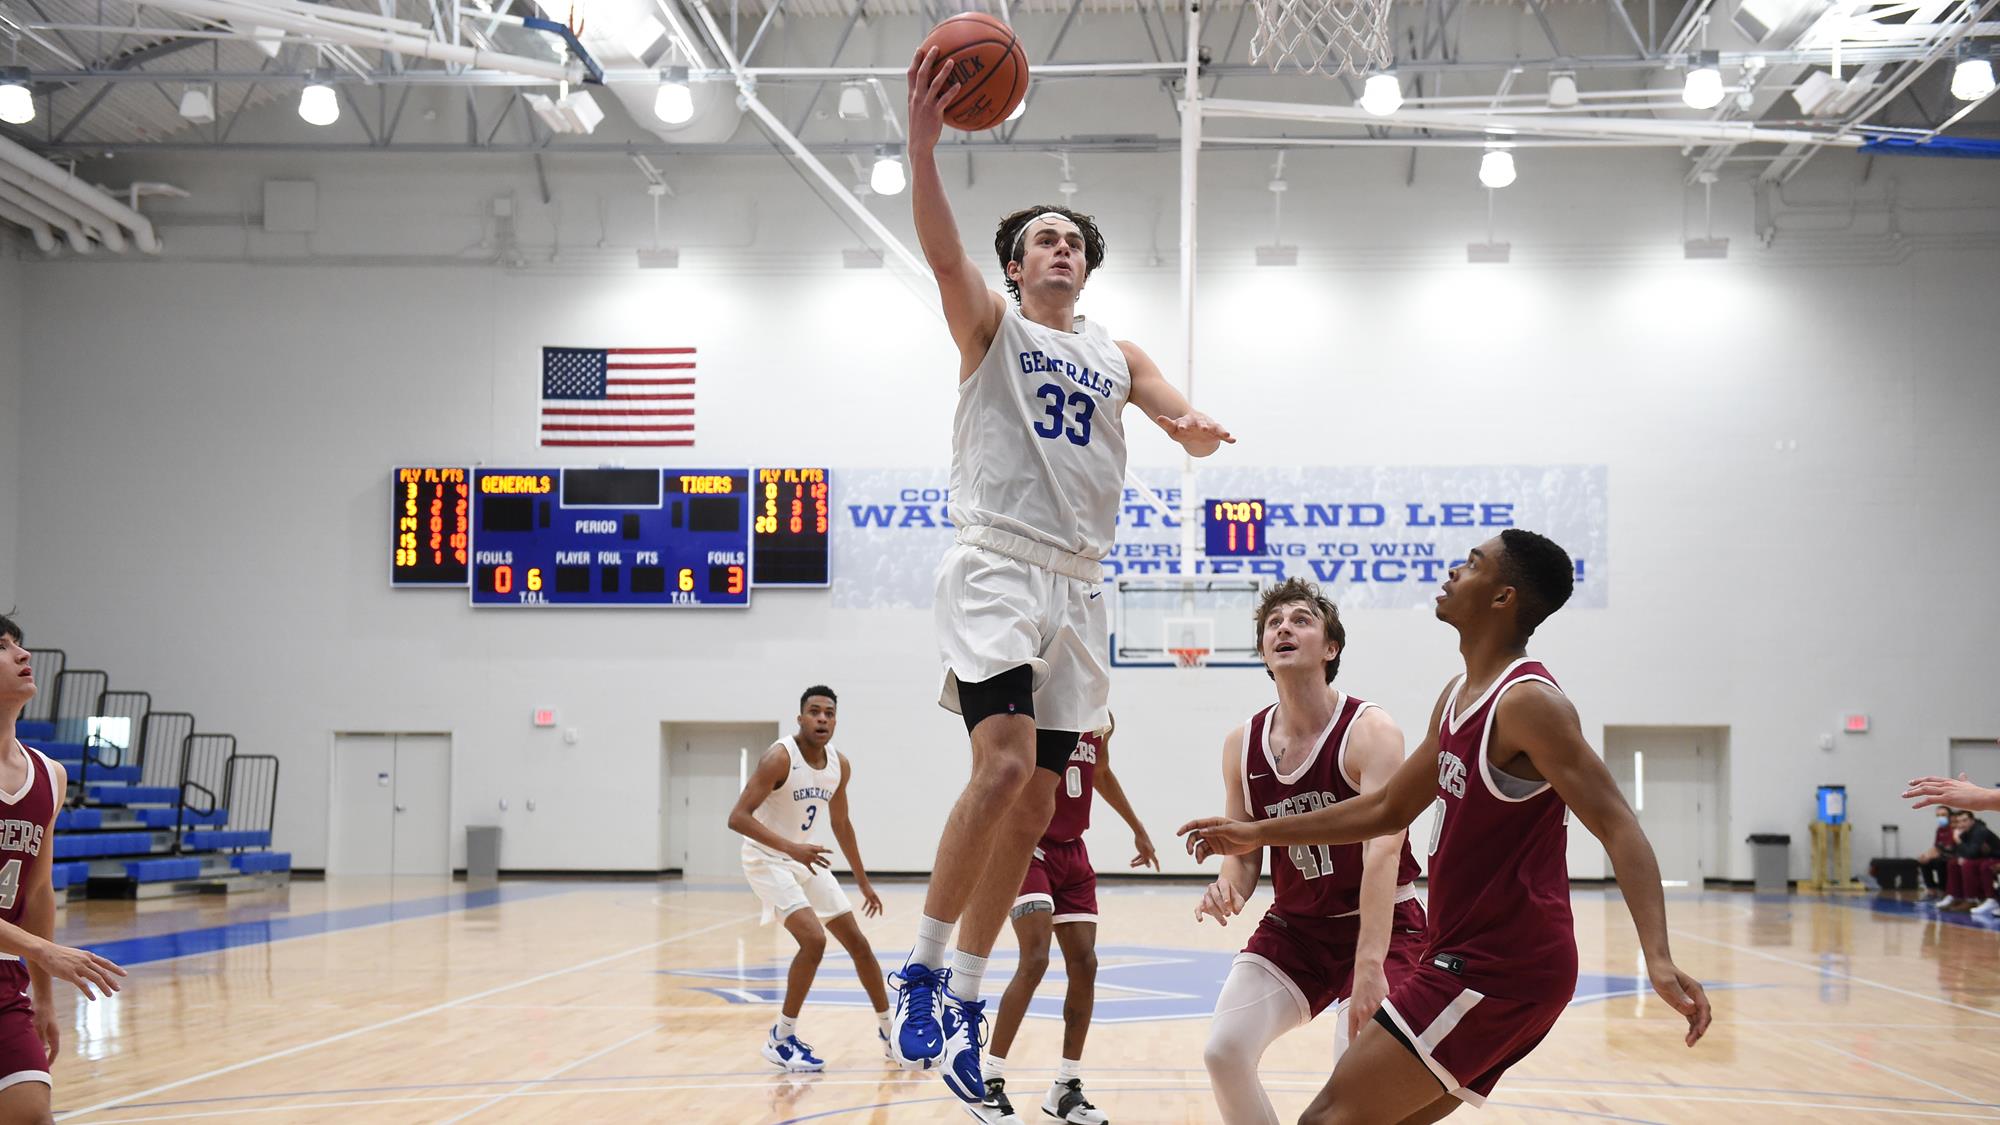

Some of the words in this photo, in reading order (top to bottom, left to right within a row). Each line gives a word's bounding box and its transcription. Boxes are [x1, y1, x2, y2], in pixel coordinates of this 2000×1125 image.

[1033, 383, 1096, 447] 33
[400, 468, 422, 483] PLY
[441, 468, 465, 483] PTS
[481, 475, 551, 494] GENERALS
[679, 475, 733, 494] TIGERS
[759, 468, 781, 483] PLY
[801, 468, 824, 483] PTS
[407, 482, 418, 499] 3
[435, 483, 443, 498] 1
[455, 483, 468, 498] 4
[765, 482, 778, 500] 0
[795, 483, 803, 498] 1
[810, 483, 828, 499] 12
[900, 488, 949, 502] CO
[405, 499, 418, 516] 5
[430, 499, 443, 516] 2
[455, 499, 468, 516] 2
[765, 499, 778, 516] 5
[791, 499, 803, 516] 3
[815, 499, 828, 516] 5
[1214, 501, 1263, 523] 17:07
[1263, 503, 1386, 527] AND
[1405, 503, 1515, 527] LEE
[400, 516, 418, 532] 14
[429, 515, 443, 533] 0
[456, 515, 468, 533] 3
[575, 520, 617, 534] PERIOD
[755, 515, 778, 534] 20
[790, 515, 803, 534] 0
[816, 515, 828, 534] 3
[400, 531, 417, 549] 15
[429, 532, 443, 549] 2
[450, 532, 467, 549] 10
[1228, 522, 1255, 552] 11
[396, 548, 417, 567] 33
[434, 549, 442, 566] 1
[476, 551, 513, 565] FOULS
[555, 551, 590, 565] PLAYER
[598, 551, 622, 565] FOUL
[636, 551, 658, 565] PTS
[707, 551, 745, 565] FOULS
[1318, 543, 1359, 557] TO
[1370, 543, 1435, 557] WIN
[494, 565, 513, 594] 0
[527, 568, 542, 591] 6
[678, 568, 694, 592] 6
[727, 566, 744, 594] 3
[1065, 765, 1083, 798] 0
[801, 804, 817, 831] 3
[0, 819, 44, 857] ERS
